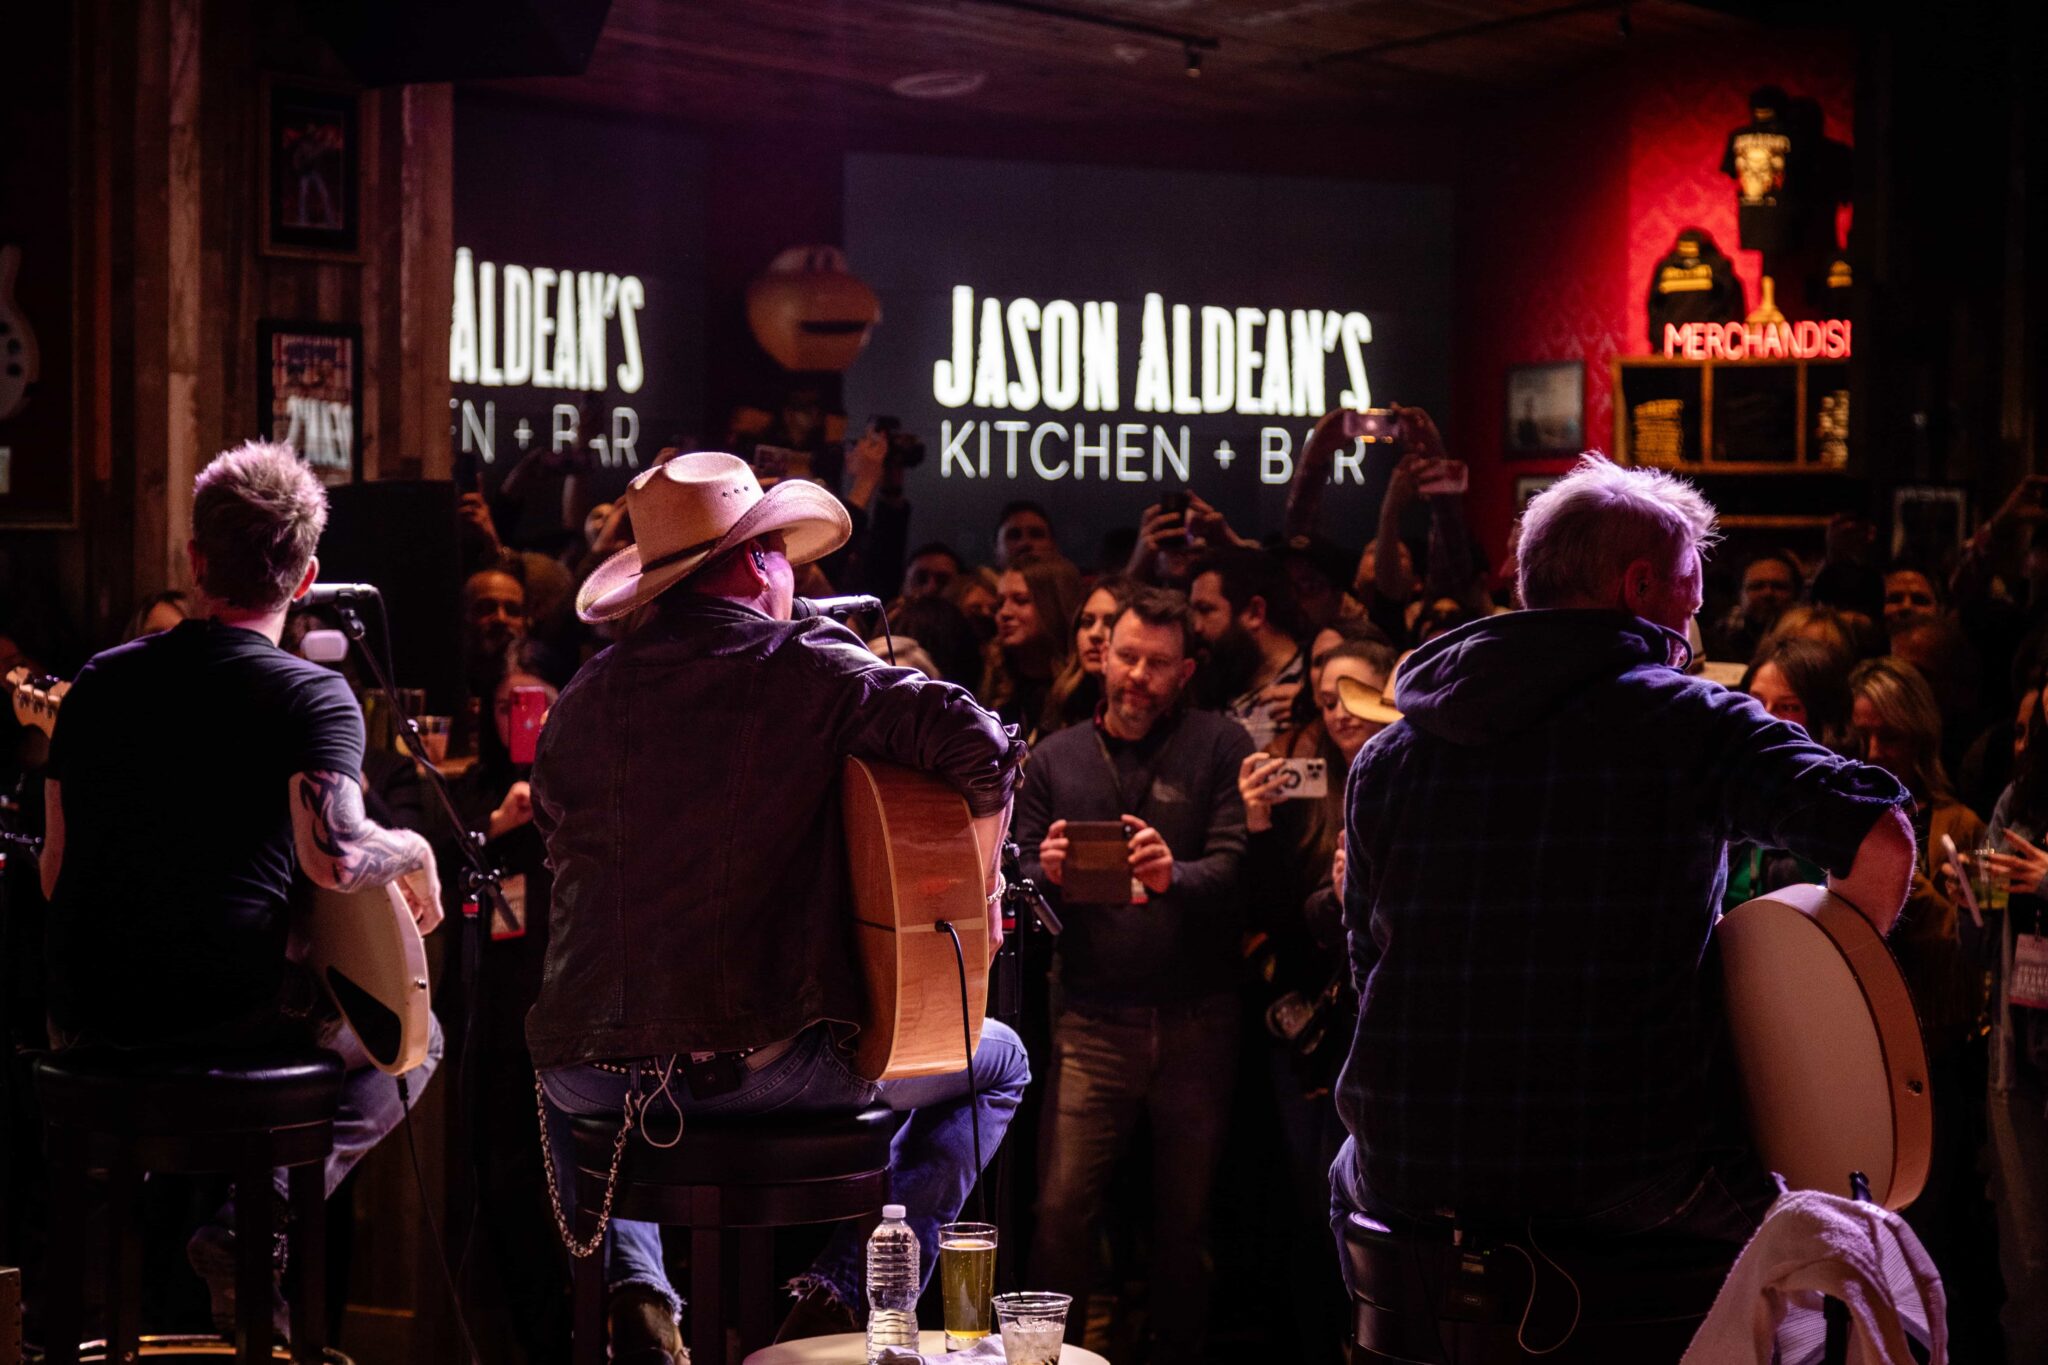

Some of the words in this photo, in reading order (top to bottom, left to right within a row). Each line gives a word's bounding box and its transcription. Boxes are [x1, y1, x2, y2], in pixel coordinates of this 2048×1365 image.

[449, 247, 645, 393] ALDEAN'S
[933, 284, 1119, 411] JASON
[1134, 292, 1372, 416] ALDEAN'S
[940, 420, 1190, 482] KITCHEN
[1213, 439, 1236, 469] +
[1260, 427, 1366, 485] BR
